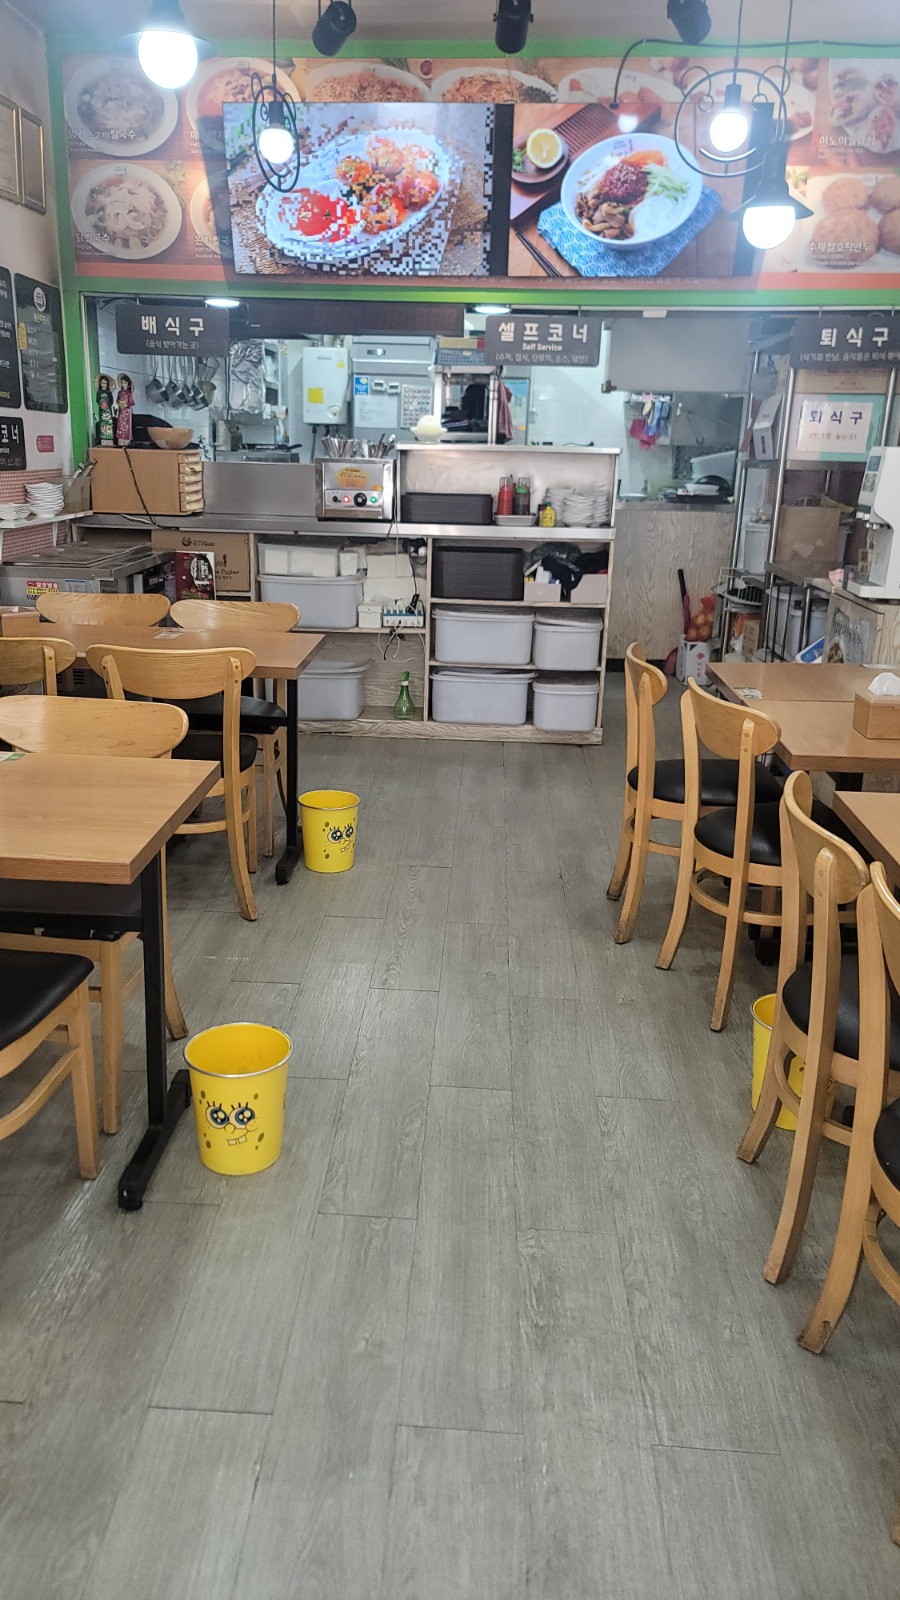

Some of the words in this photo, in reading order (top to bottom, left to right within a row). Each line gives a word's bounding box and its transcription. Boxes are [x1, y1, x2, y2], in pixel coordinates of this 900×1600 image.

[194, 234, 230, 246] 완자쌀국
[498, 321, 588, 344] 셀프코너
[146, 339, 161, 348] (음식
[163, 340, 188, 350] 받아가는
[522, 343, 536, 351] Self
[537, 343, 562, 352] Service
